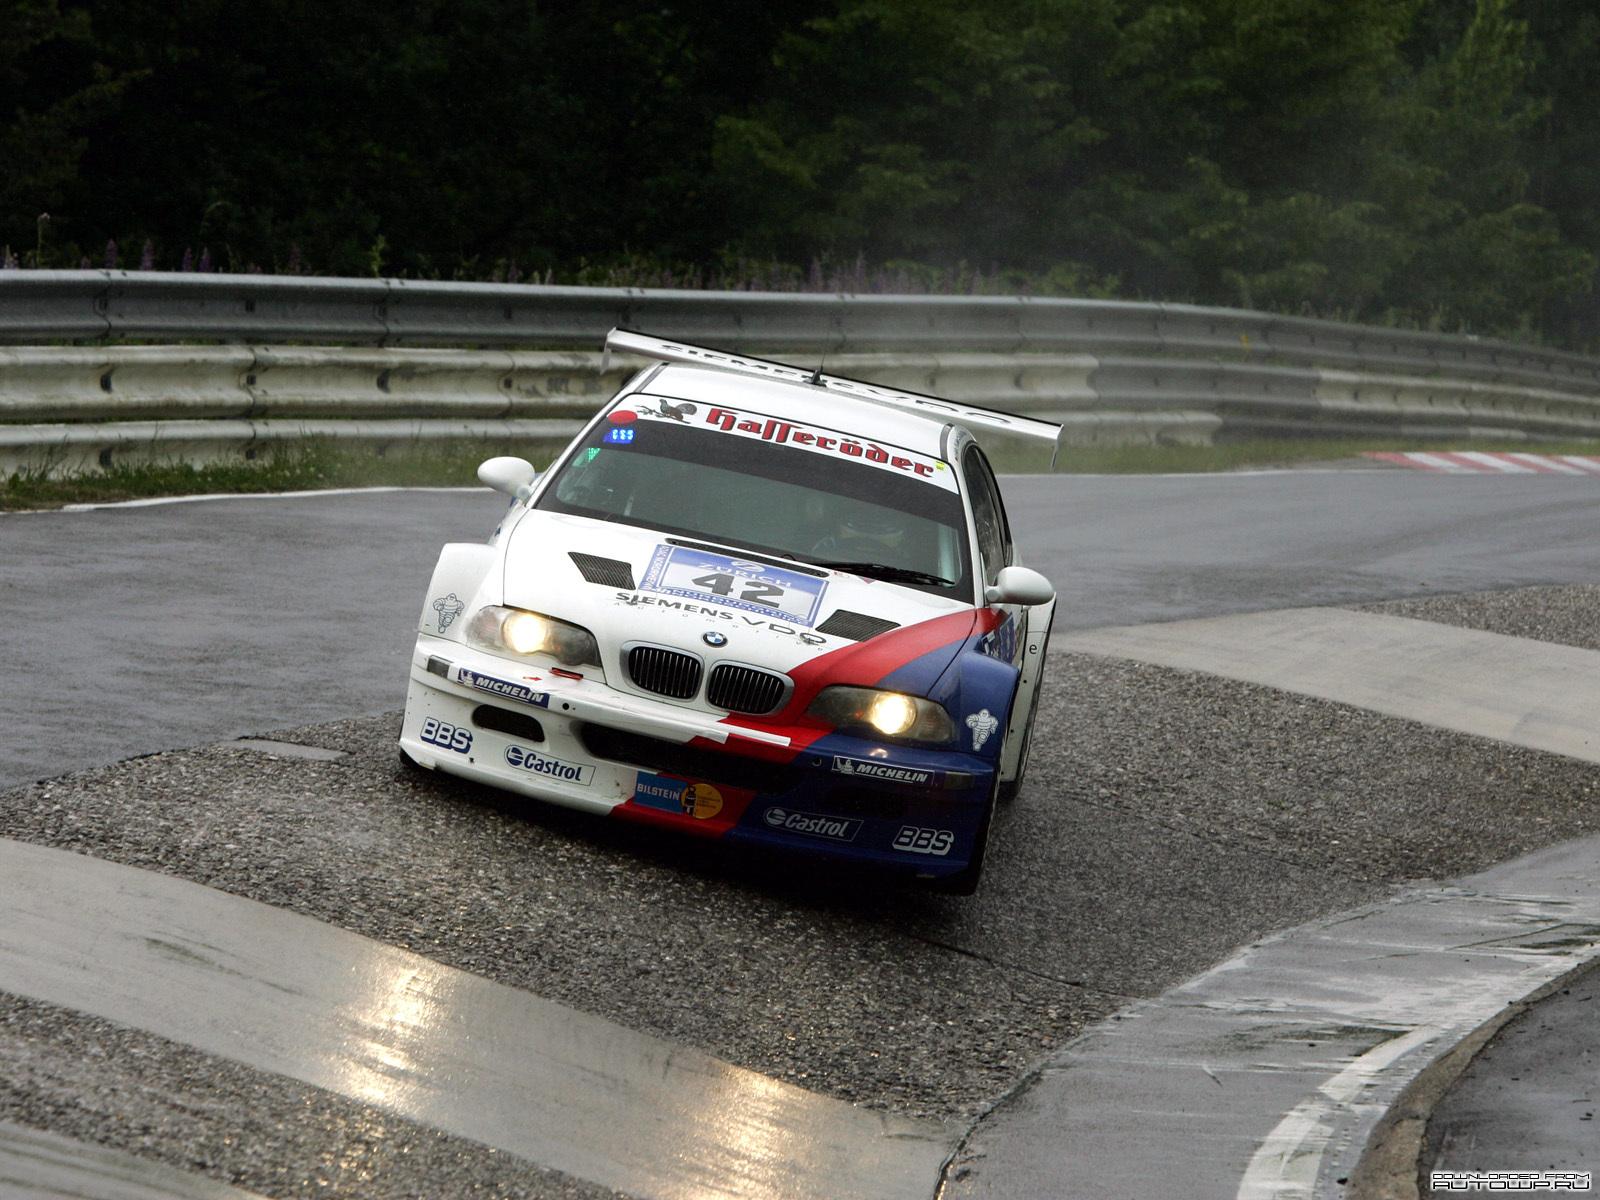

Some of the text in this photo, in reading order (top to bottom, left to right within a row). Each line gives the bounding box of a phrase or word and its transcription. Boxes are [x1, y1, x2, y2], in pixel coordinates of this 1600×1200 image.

[691, 572, 784, 608] 42
[615, 591, 734, 621] SIEMENS
[741, 616, 827, 646] VDO
[475, 677, 545, 703] MICHELIN
[420, 716, 473, 754] BBS
[523, 752, 582, 782] Castrol
[856, 763, 928, 783] MICHELIN
[636, 783, 680, 801] BILSTEIN
[784, 813, 850, 838] Castrol
[892, 825, 955, 856] BBS
